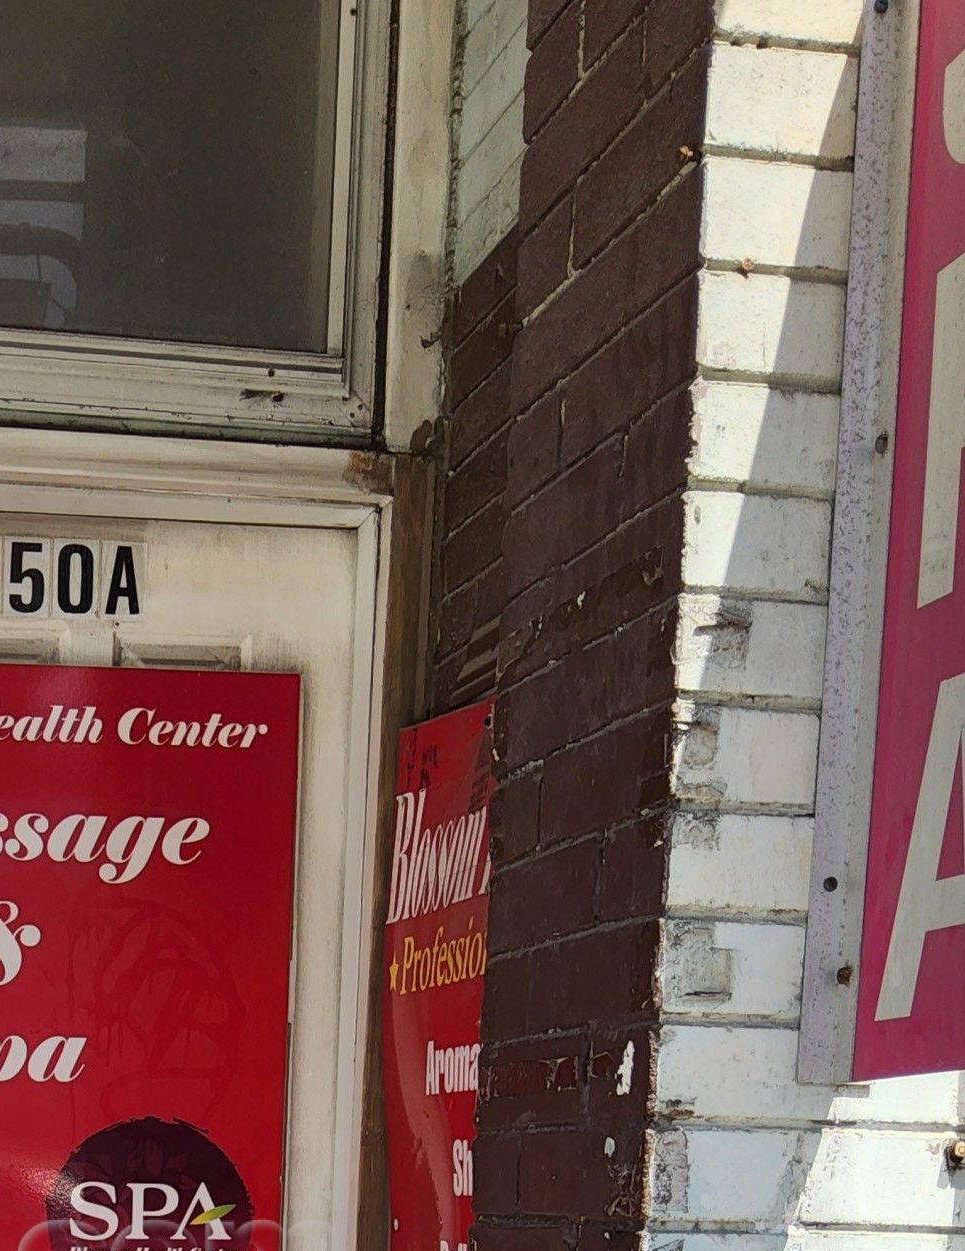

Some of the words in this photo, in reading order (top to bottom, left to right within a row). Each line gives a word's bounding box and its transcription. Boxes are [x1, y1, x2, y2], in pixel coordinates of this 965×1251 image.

[117, 707, 269, 749] Center
[386, 788, 487, 926] Blossom
[69, 1181, 236, 1242] SPA
